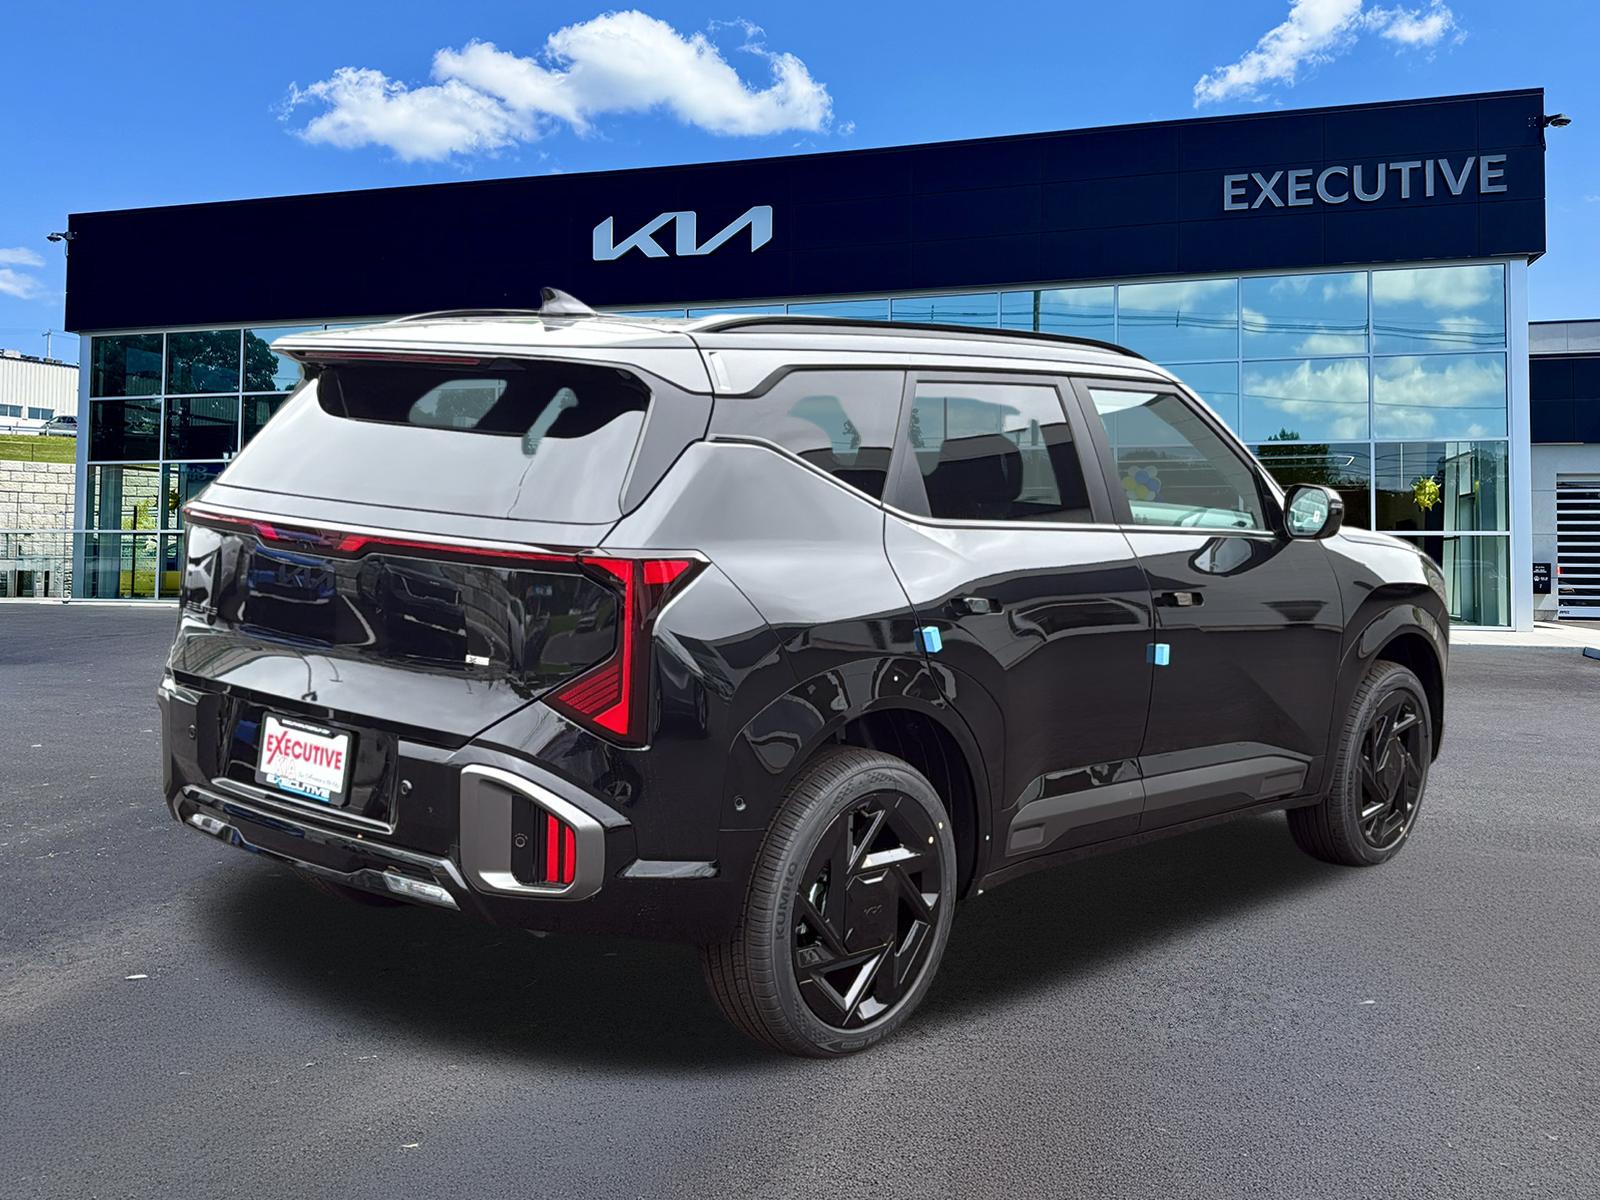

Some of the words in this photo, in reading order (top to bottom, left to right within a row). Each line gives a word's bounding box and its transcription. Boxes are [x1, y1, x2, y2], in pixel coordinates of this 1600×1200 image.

[1223, 154, 1508, 211] EXECUTIVE
[593, 205, 773, 261] KIA
[266, 731, 343, 770] EXECUTIVE
